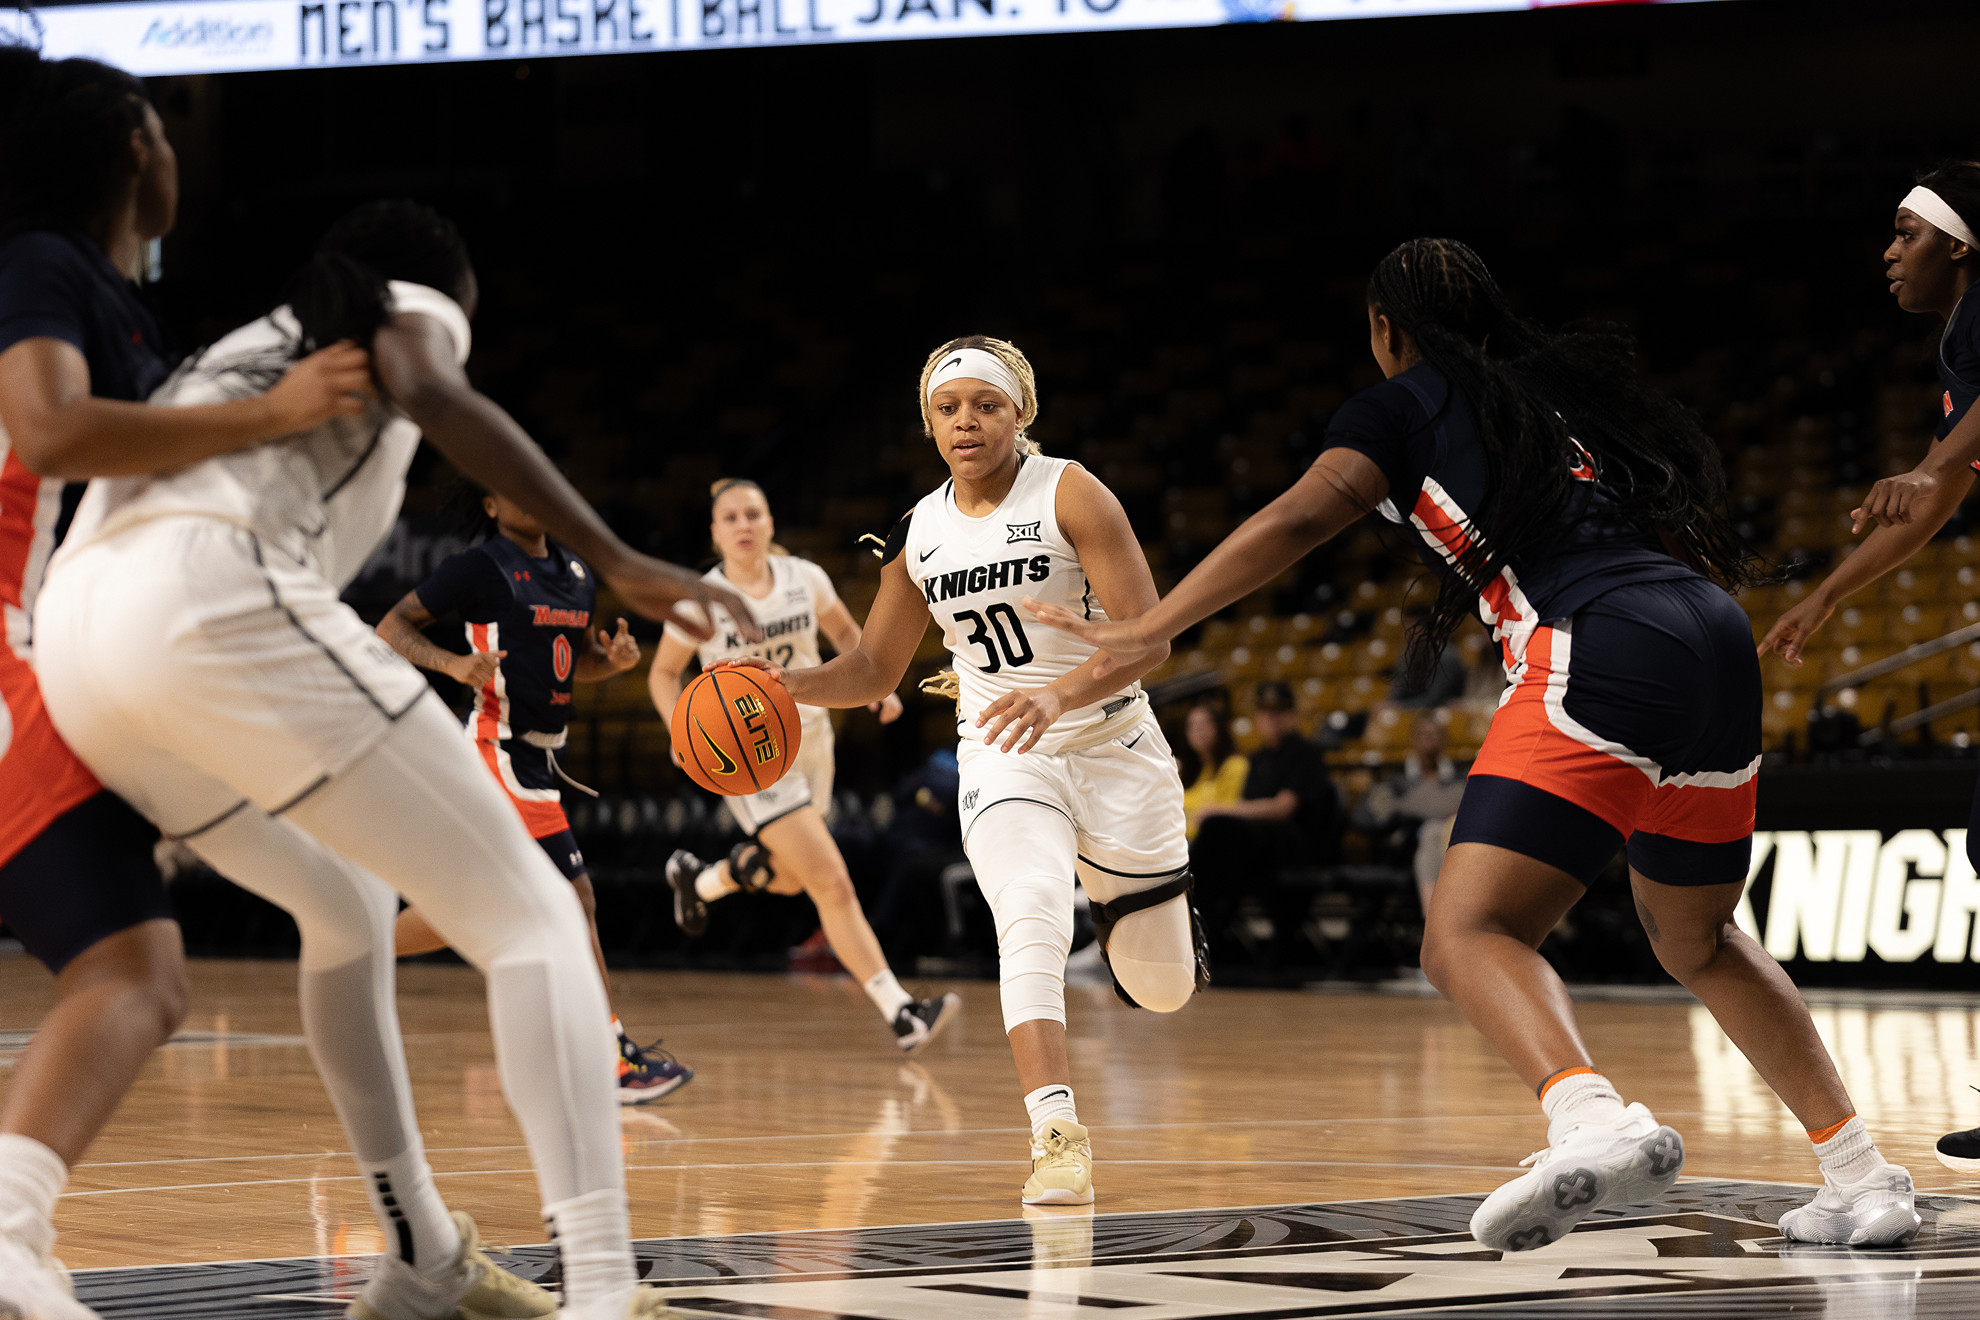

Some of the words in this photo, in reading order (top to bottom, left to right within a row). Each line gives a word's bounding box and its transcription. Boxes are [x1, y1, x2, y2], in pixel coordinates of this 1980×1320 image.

[923, 555, 1050, 604] KNIGHTS
[552, 633, 572, 682] 0
[953, 602, 1034, 674] 30
[733, 693, 775, 765] ELITE
